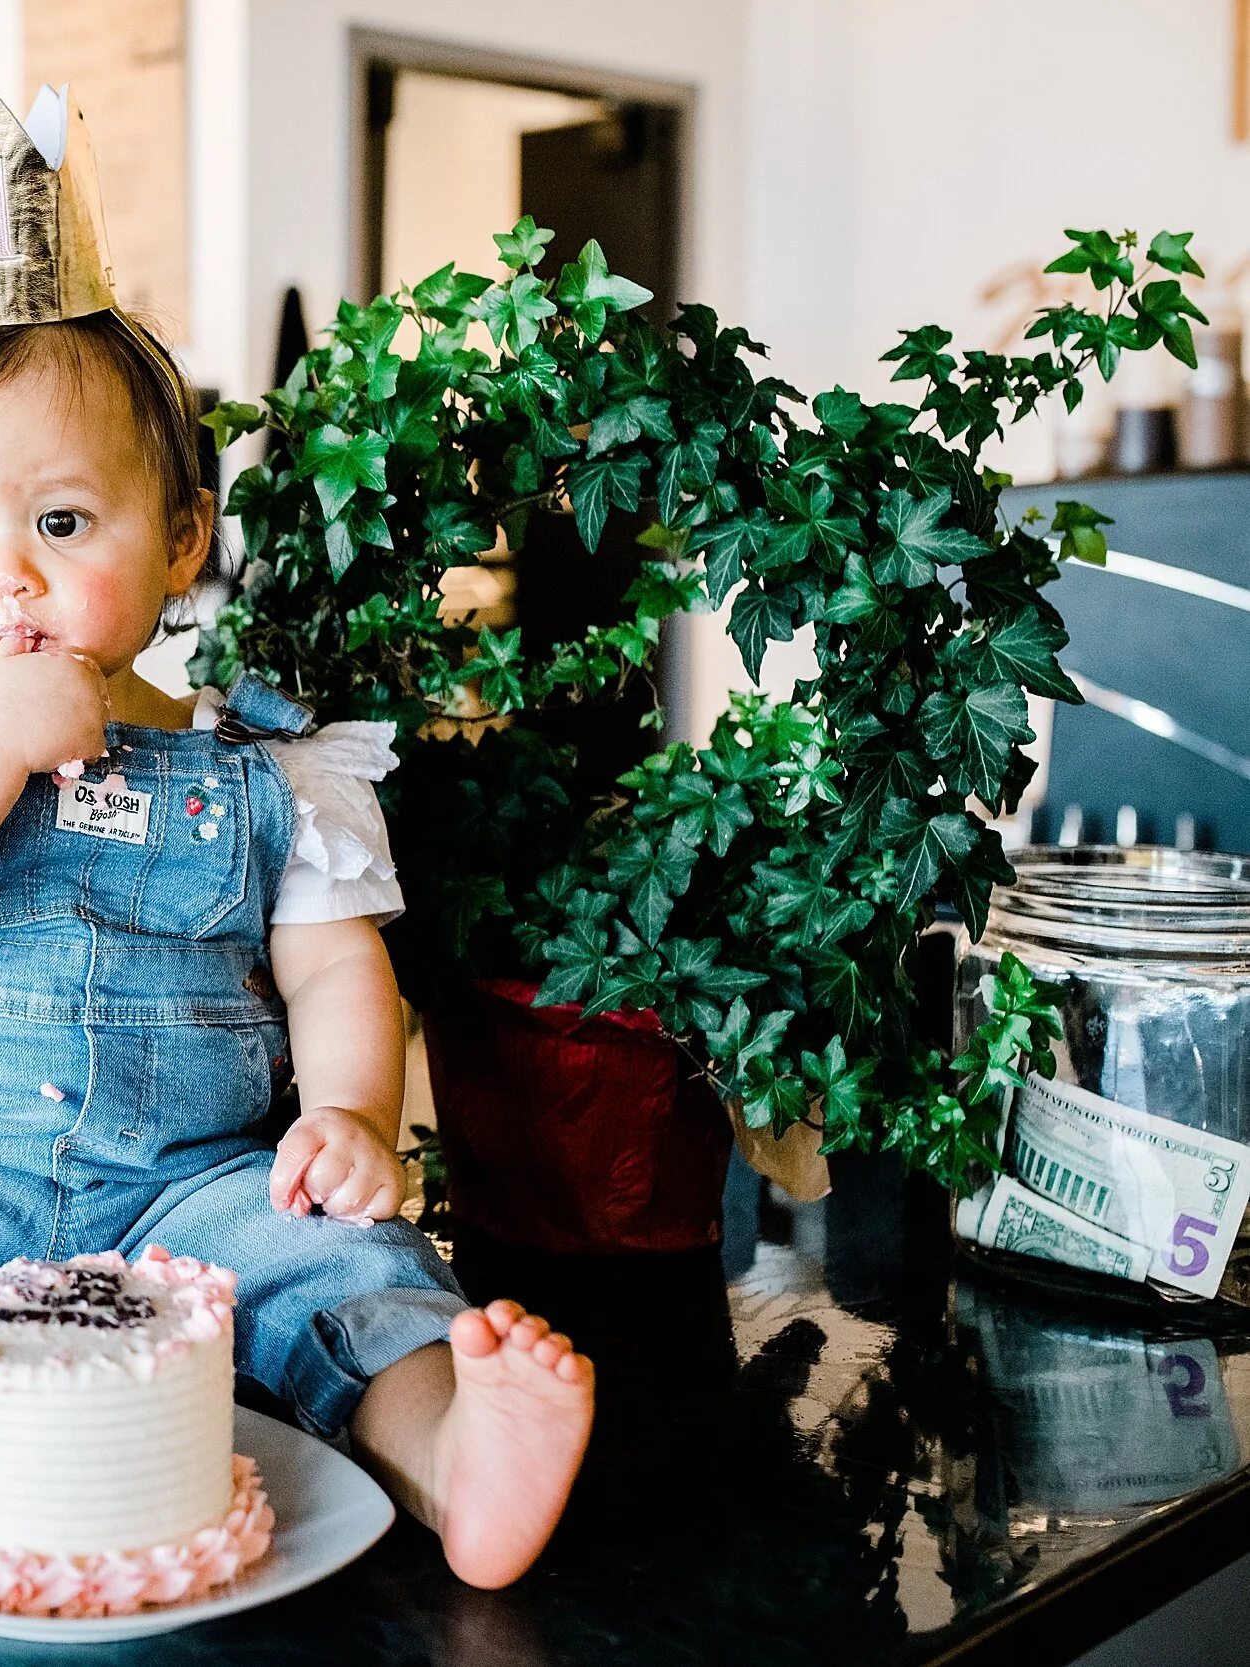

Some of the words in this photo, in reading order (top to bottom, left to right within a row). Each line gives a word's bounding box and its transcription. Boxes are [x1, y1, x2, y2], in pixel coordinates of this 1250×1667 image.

[74, 785, 140, 813] OSKOSH
[62, 819, 76, 828] THE
[79, 821, 106, 834] GENUINE
[1203, 1159, 1236, 1193] 5
[1162, 1212, 1218, 1278] 5
